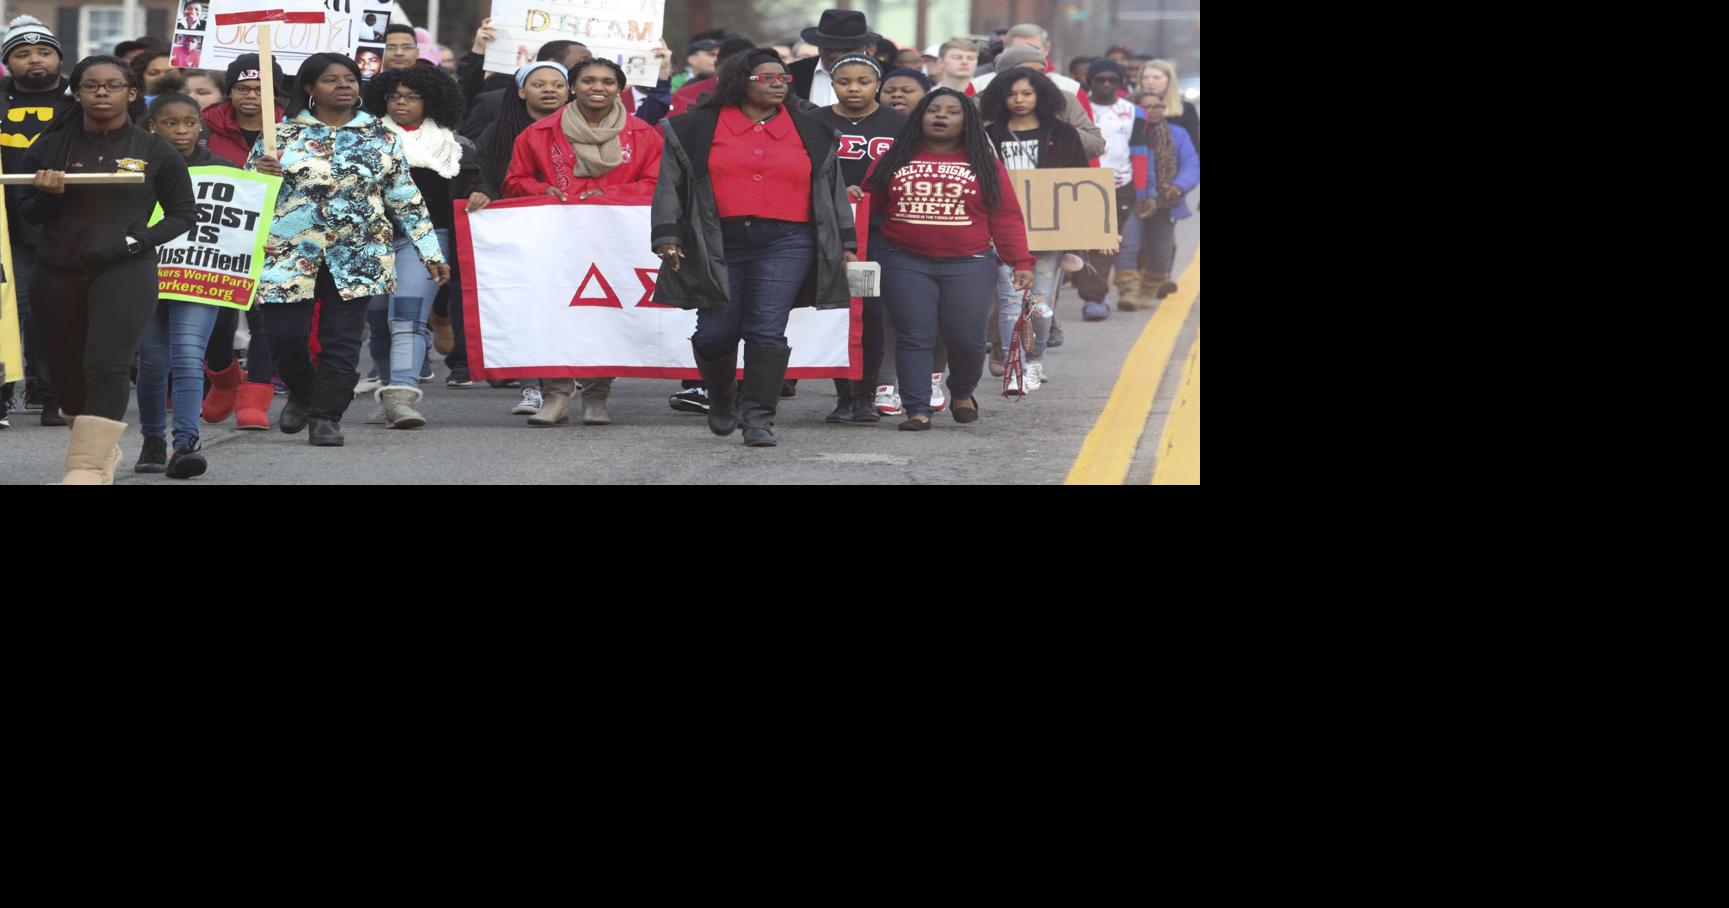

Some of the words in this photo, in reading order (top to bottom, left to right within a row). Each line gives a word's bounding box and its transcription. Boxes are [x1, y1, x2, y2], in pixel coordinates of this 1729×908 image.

[197, 182, 235, 203] TO
[903, 180, 963, 198] 1913
[897, 201, 966, 216] THETA
[187, 225, 220, 244] IS
[184, 269, 219, 284] World
[222, 275, 254, 291] Party
